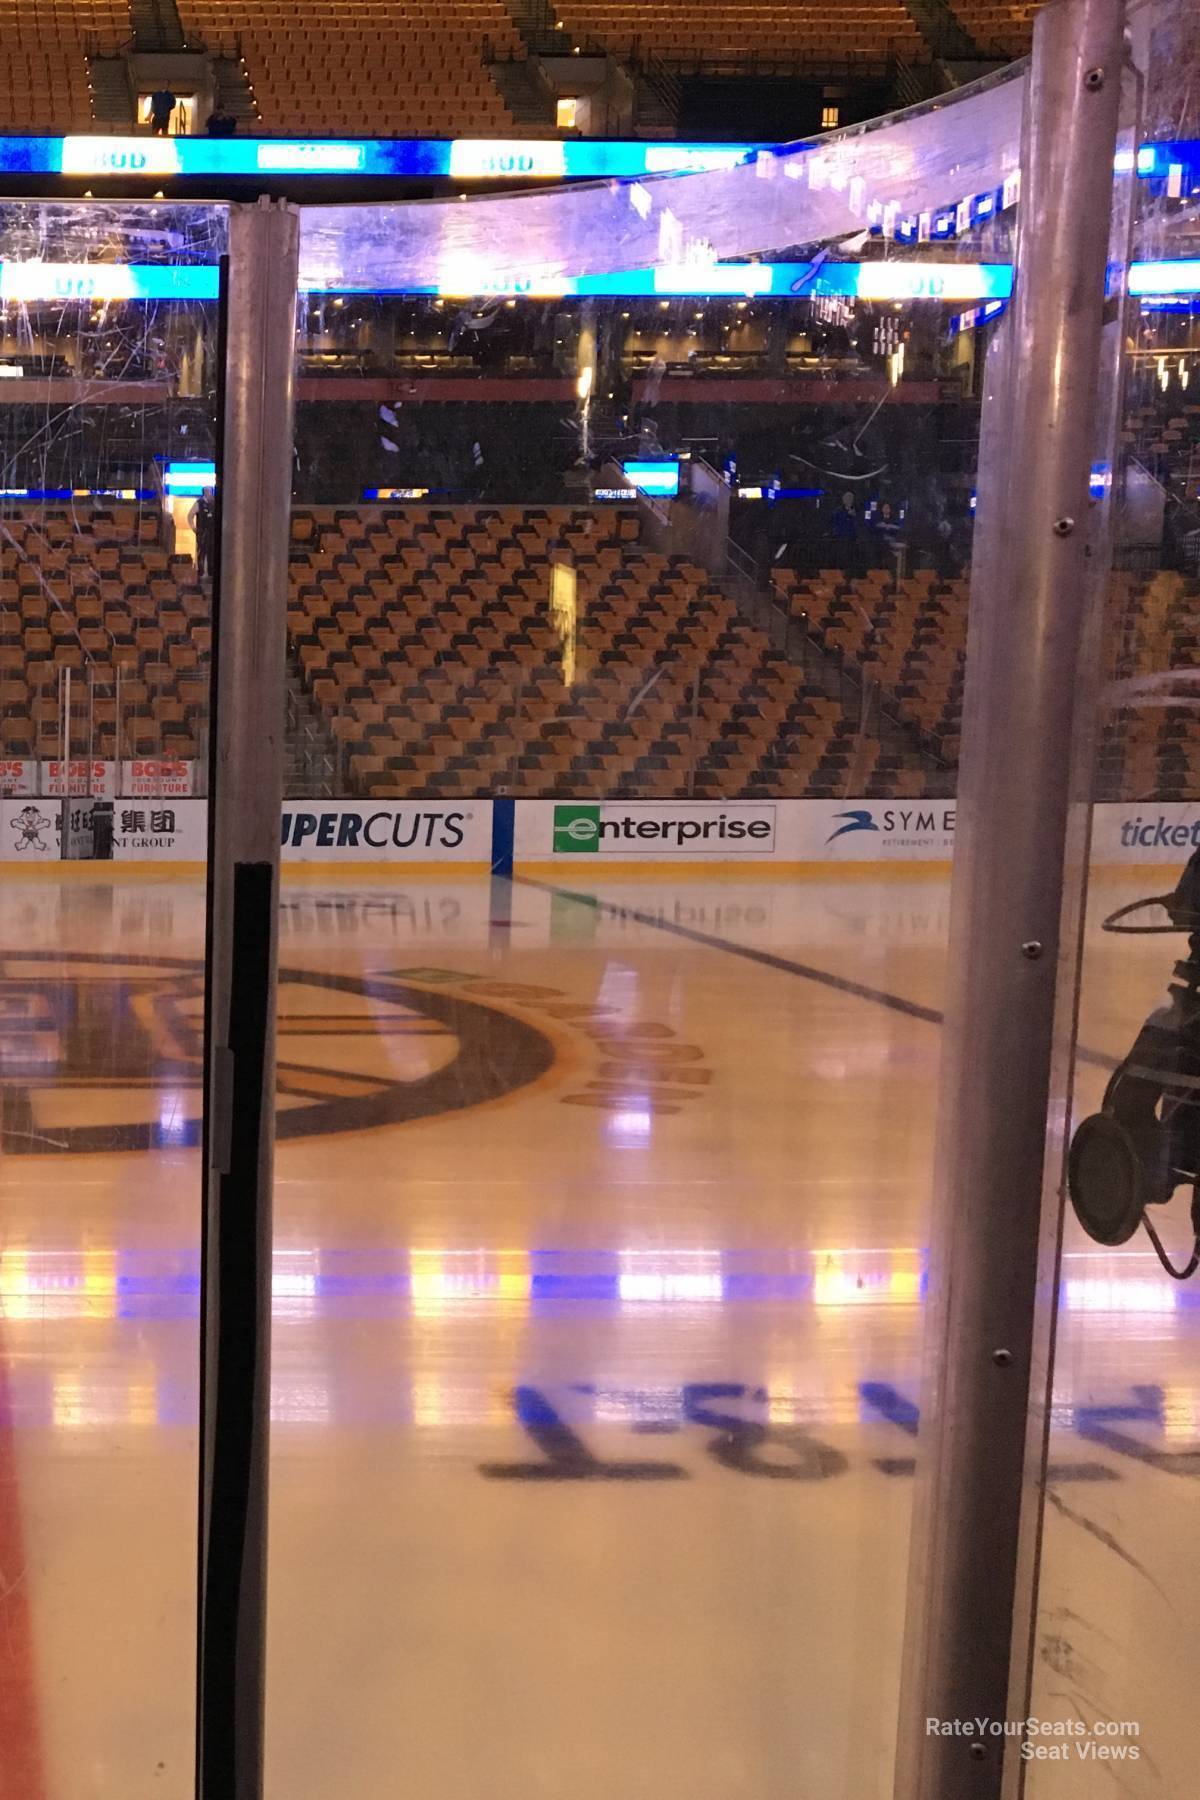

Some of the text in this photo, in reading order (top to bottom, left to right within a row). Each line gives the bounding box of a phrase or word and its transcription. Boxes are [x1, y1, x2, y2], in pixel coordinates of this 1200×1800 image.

[281, 812, 464, 848] UPERCUTS
[567, 814, 771, 845] enterprise
[883, 810, 955, 832] SYME
[132, 838, 175, 848] GROUP
